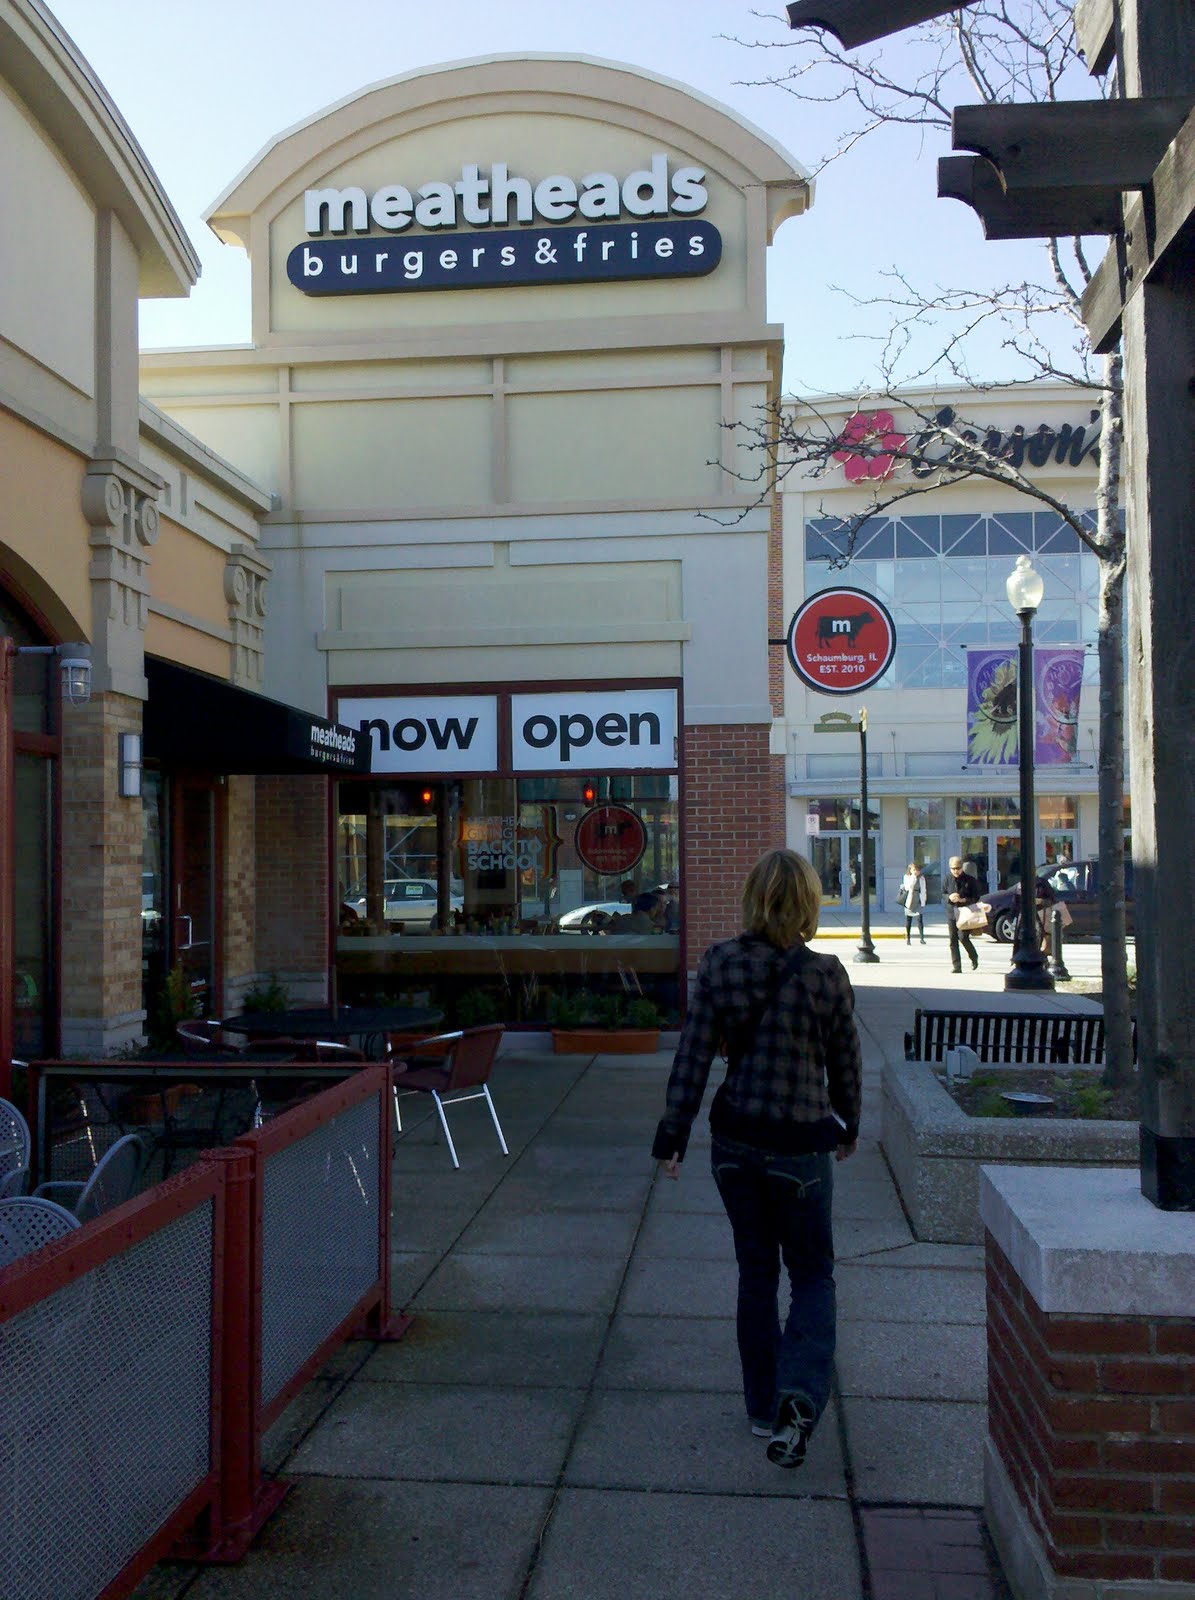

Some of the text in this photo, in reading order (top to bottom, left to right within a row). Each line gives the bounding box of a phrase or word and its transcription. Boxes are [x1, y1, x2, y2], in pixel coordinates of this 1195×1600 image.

[304, 153, 708, 236] meatheads
[911, 406, 1101, 479] Carson'
[832, 619, 851, 633] m
[819, 664, 865, 673] EST. 2010
[311, 724, 355, 753] meatheads
[361, 711, 661, 762] now open
[467, 840, 542, 855] BACK TO
[467, 855, 541, 871] SCHOOL
